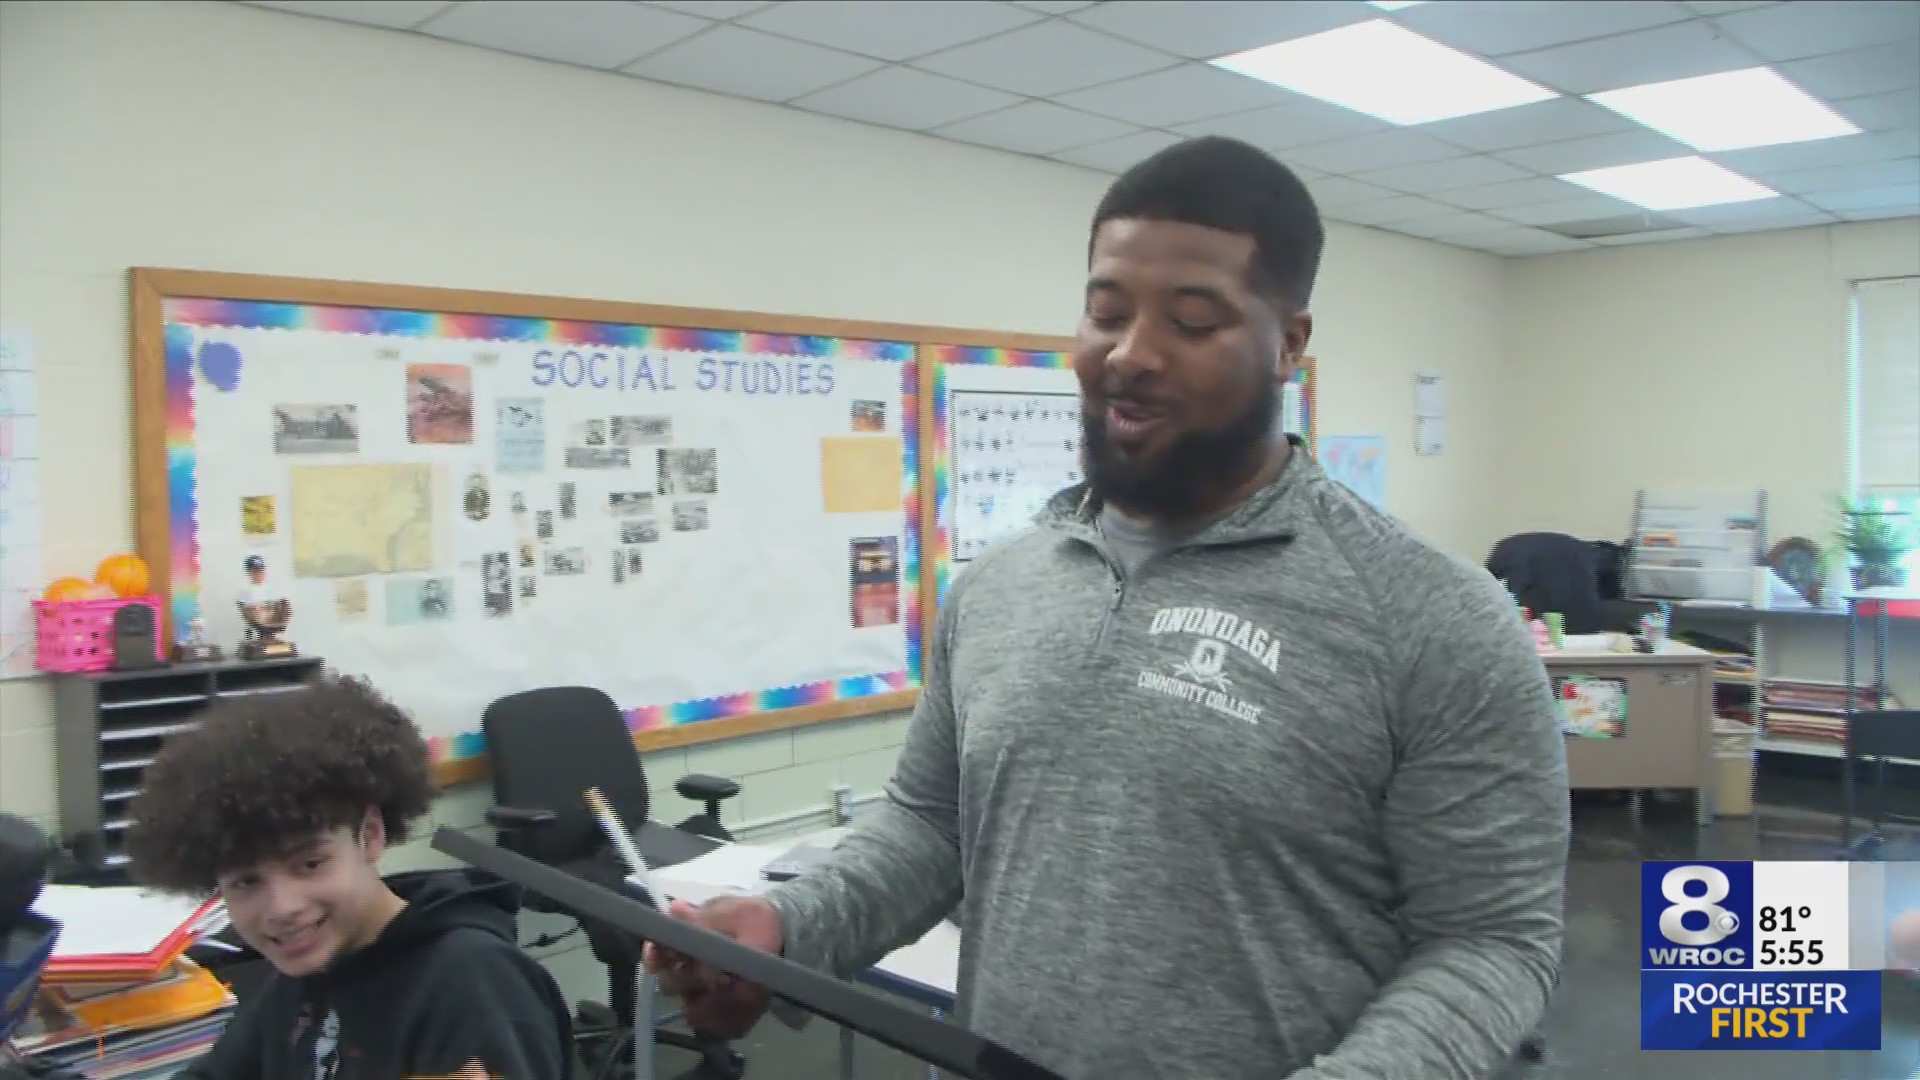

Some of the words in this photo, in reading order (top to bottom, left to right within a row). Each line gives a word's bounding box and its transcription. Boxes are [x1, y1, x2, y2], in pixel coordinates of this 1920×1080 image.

[531, 349, 677, 391] SOCIAL
[696, 358, 835, 395] STUDIES
[1149, 607, 1281, 674] ONONDAGA
[1137, 671, 1206, 703] COMMUNITY
[1205, 690, 1262, 725] COLLEGE
